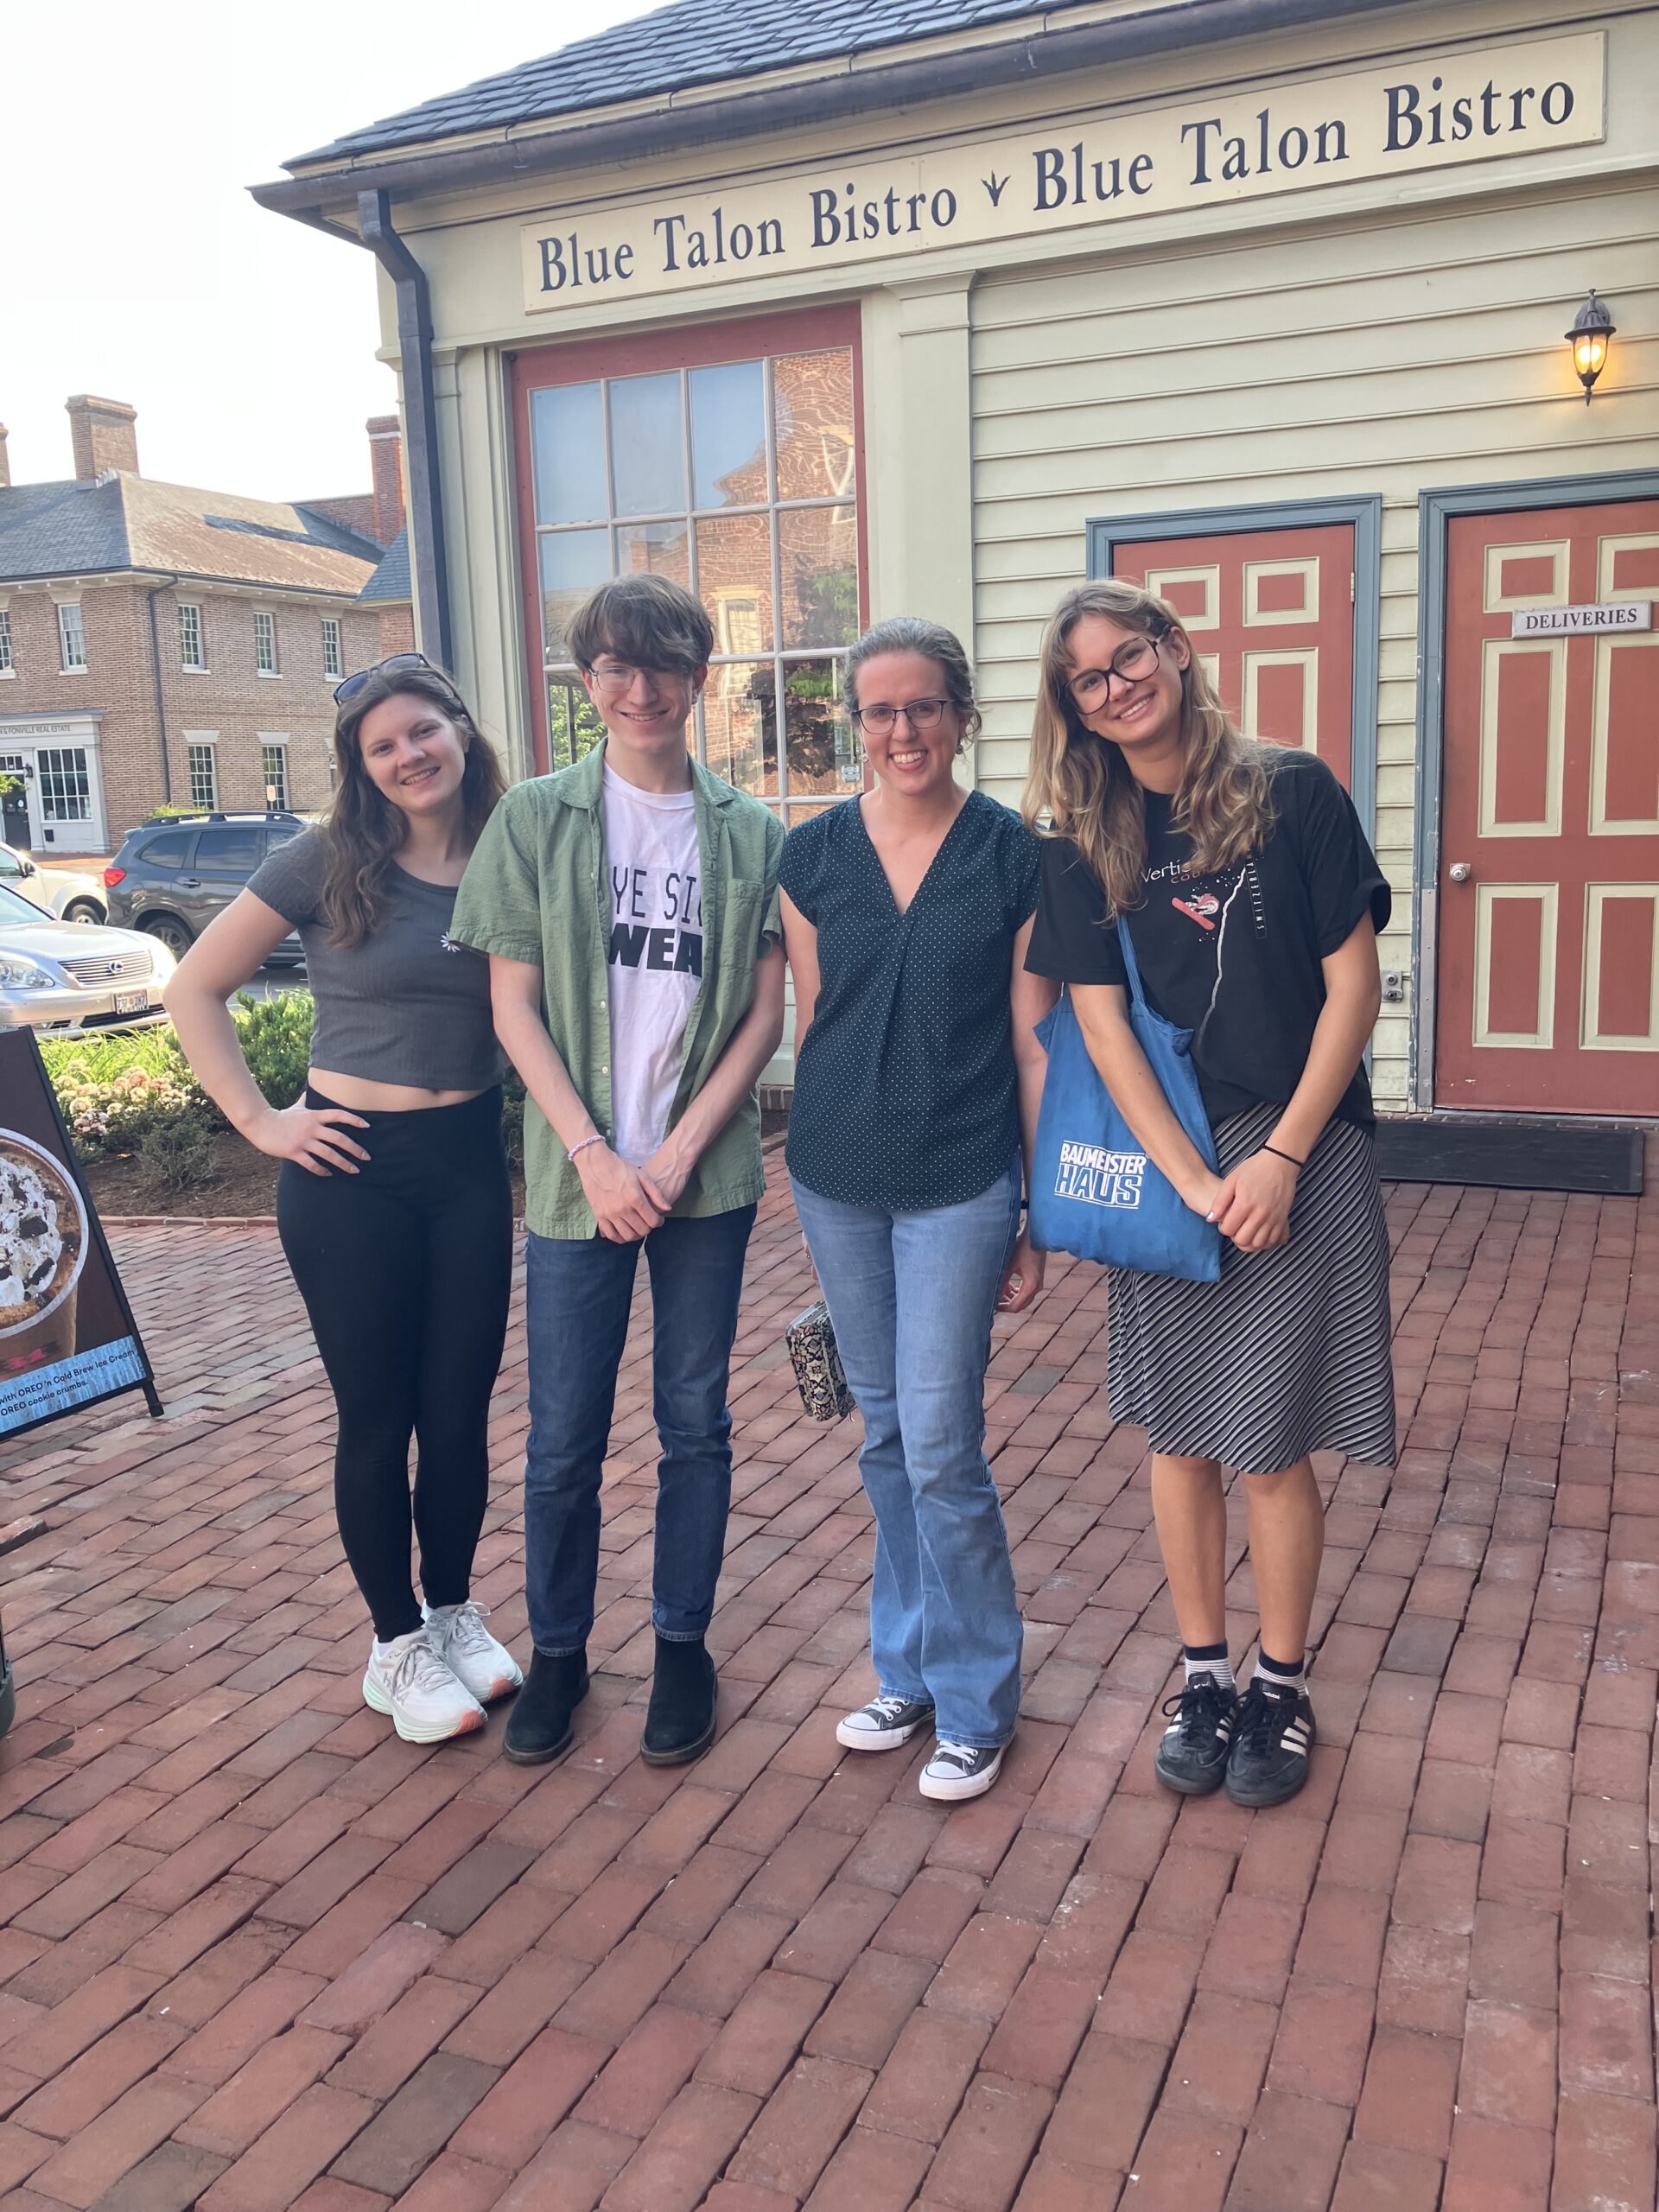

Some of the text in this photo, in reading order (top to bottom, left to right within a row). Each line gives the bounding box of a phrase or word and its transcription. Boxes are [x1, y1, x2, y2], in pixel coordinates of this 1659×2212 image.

[537, 76, 1575, 293] Blue Talon Bistro Blue Talon Bistro
[1525, 608, 1637, 630] DELIVERIES
[1060, 1143, 1147, 1175] BAUMEISTER
[1055, 1164, 1142, 1206] HAUS
[18, 1382, 43, 1396] OREO
[53, 1370, 73, 1383] Cold
[73, 1362, 94, 1376] Brew
[109, 1350, 135, 1363] Cream
[1, 1402, 26, 1416] OREO
[28, 1392, 54, 1406] cookie
